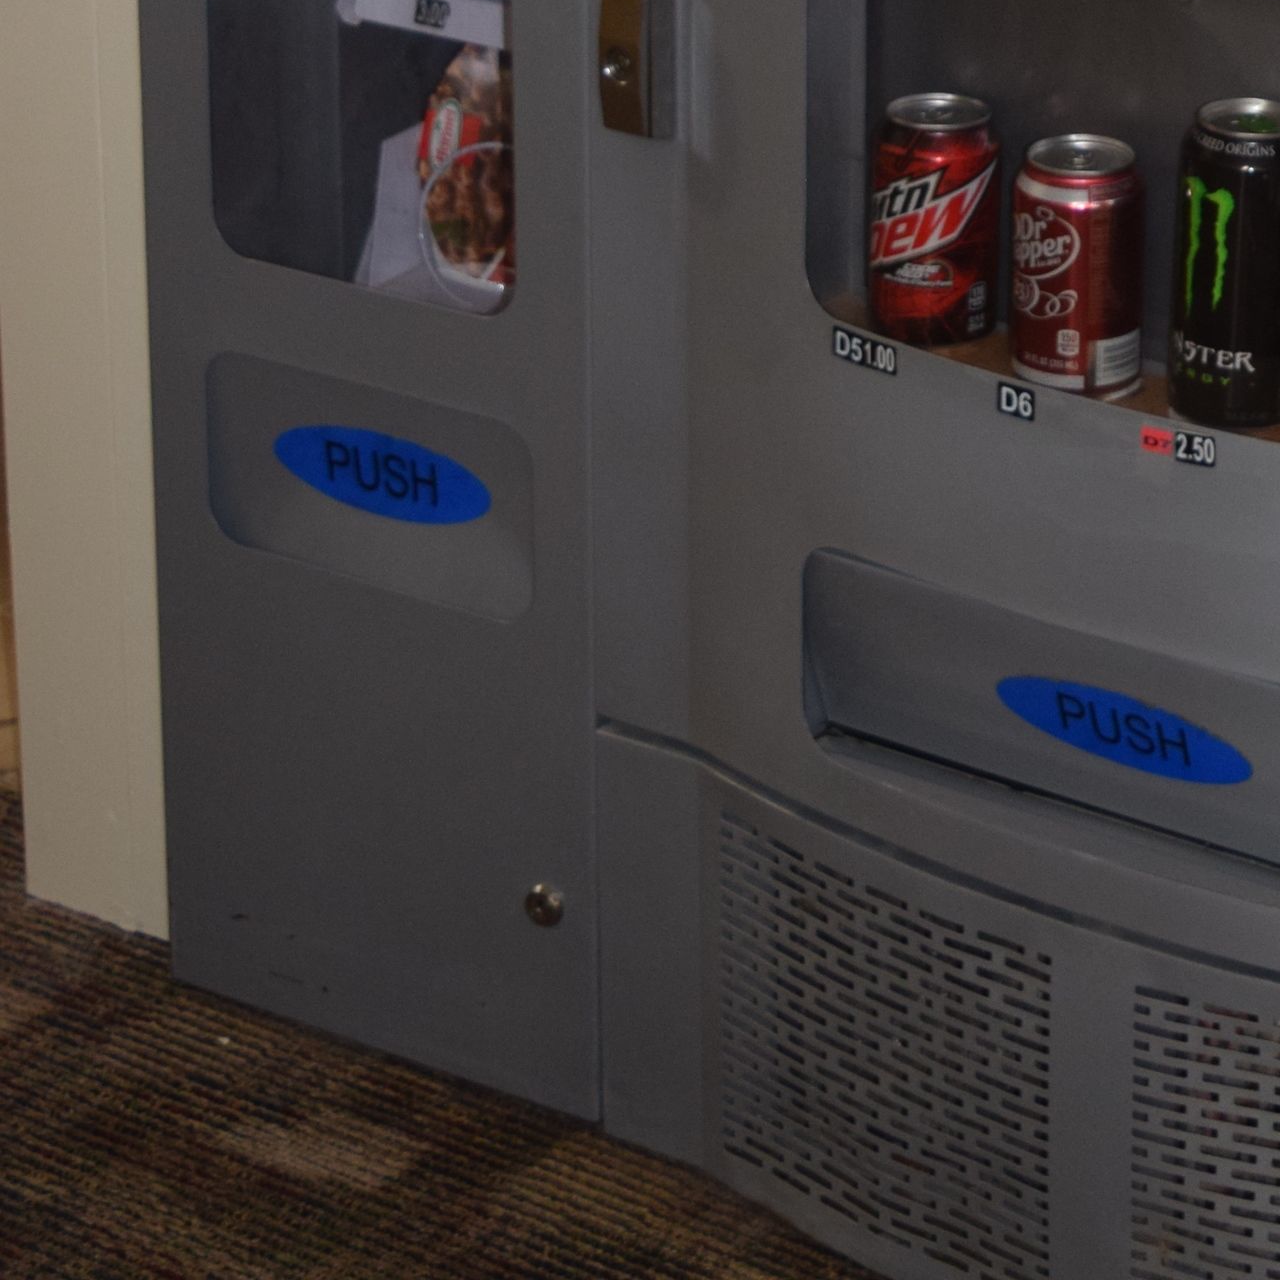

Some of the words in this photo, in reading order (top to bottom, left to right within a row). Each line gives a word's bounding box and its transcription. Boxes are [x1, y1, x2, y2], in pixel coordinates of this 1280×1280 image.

[835, 330, 863, 360] D5
[863, 344, 896, 373] 1.00
[1000, 386, 1033, 417] D6
[1176, 432, 1216, 465] 2.50
[324, 439, 439, 508] PUSH
[1055, 691, 1191, 768] PUSH
